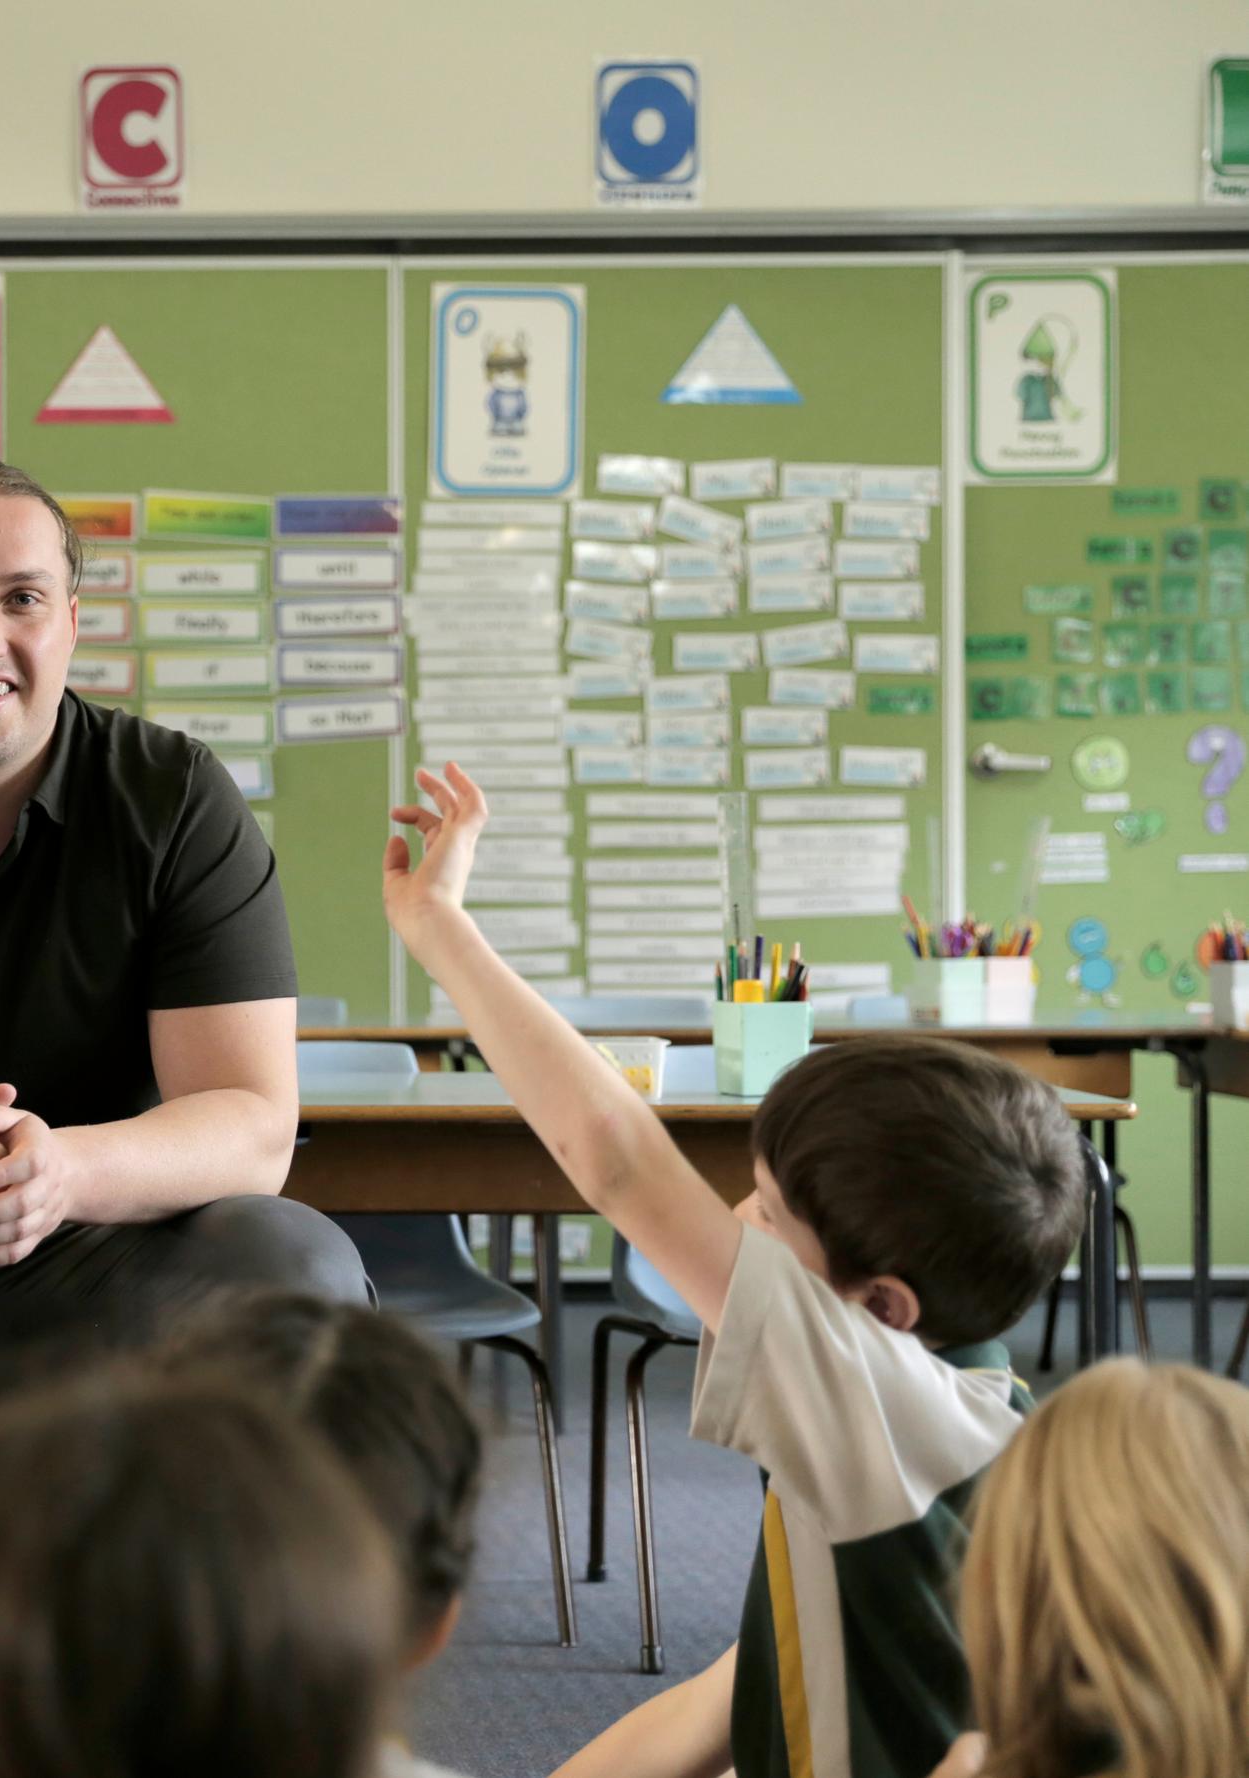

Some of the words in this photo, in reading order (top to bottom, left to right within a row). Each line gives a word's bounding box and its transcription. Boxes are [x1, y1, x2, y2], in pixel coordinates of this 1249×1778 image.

[92, 80, 168, 178] C
[605, 76, 693, 182] O
[986, 293, 1010, 321] P
